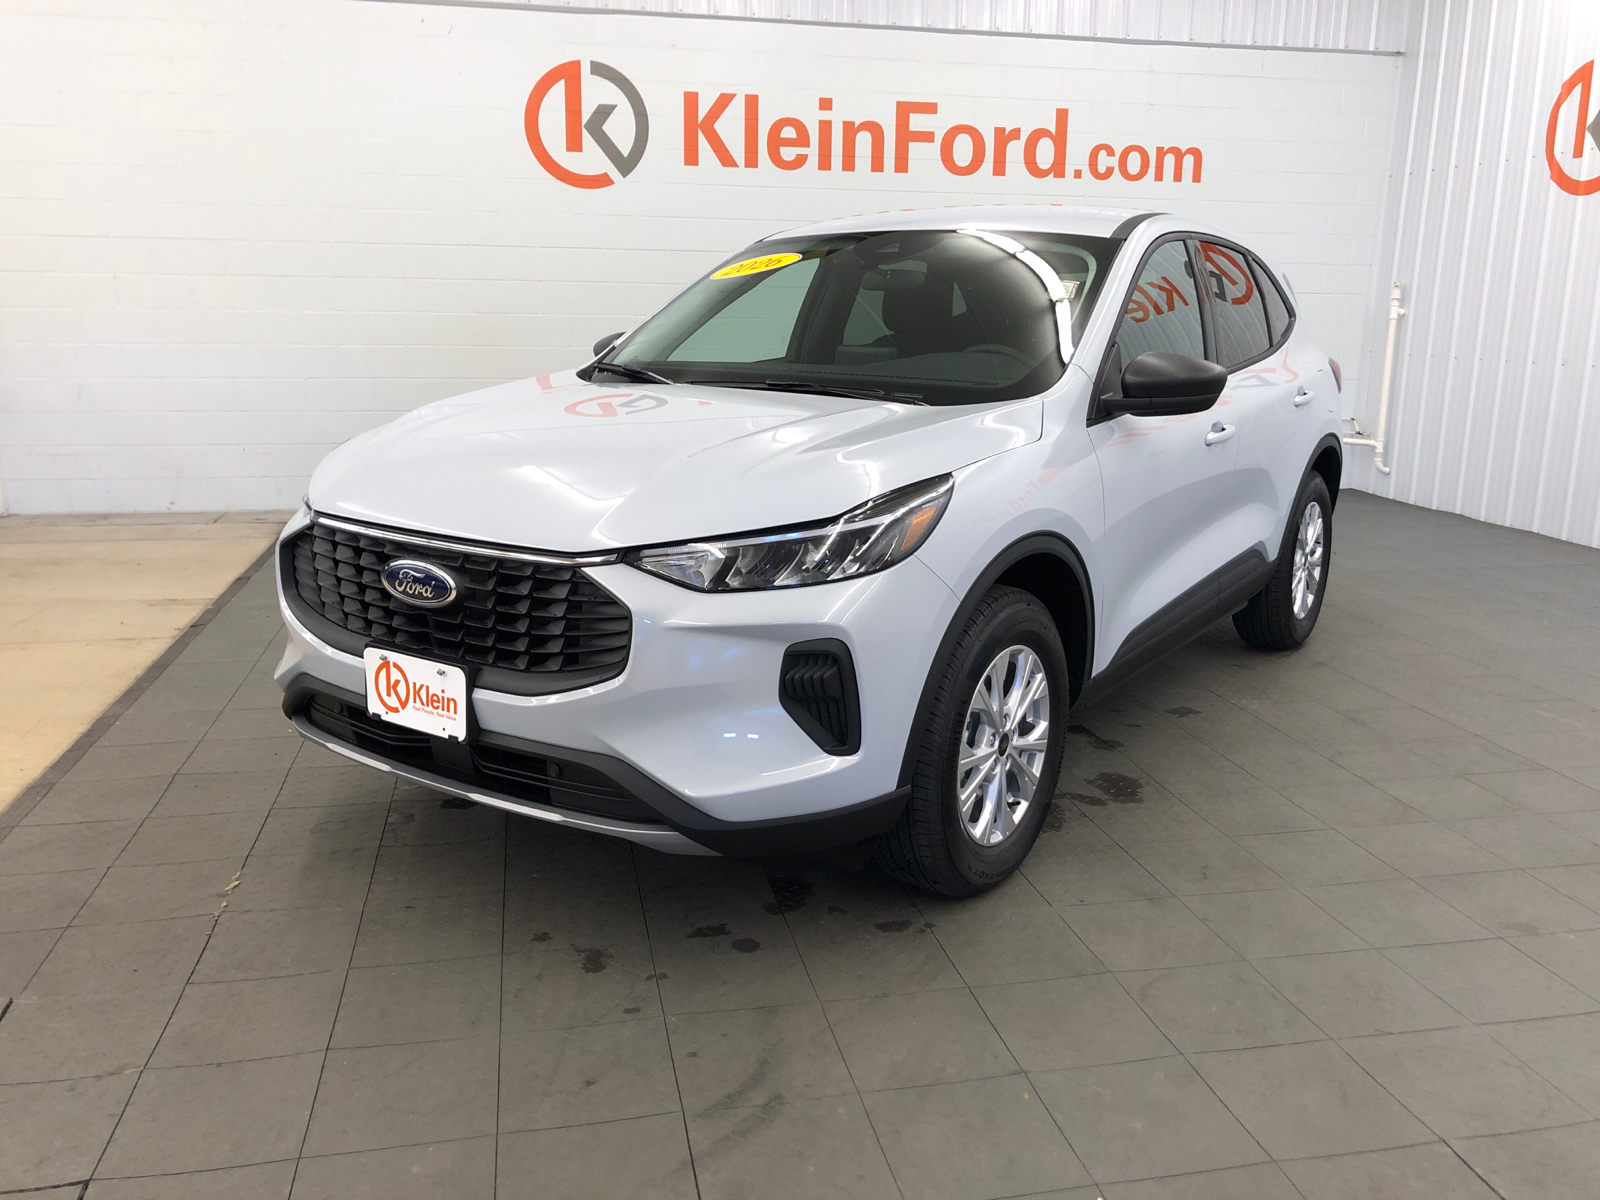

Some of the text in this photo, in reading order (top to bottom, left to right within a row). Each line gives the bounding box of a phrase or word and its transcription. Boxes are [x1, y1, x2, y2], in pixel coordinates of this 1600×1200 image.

[683, 91, 1203, 184] KleinFord.com
[721, 256, 789, 277] 2026
[395, 569, 435, 598] Ford
[413, 682, 457, 715] Klein
